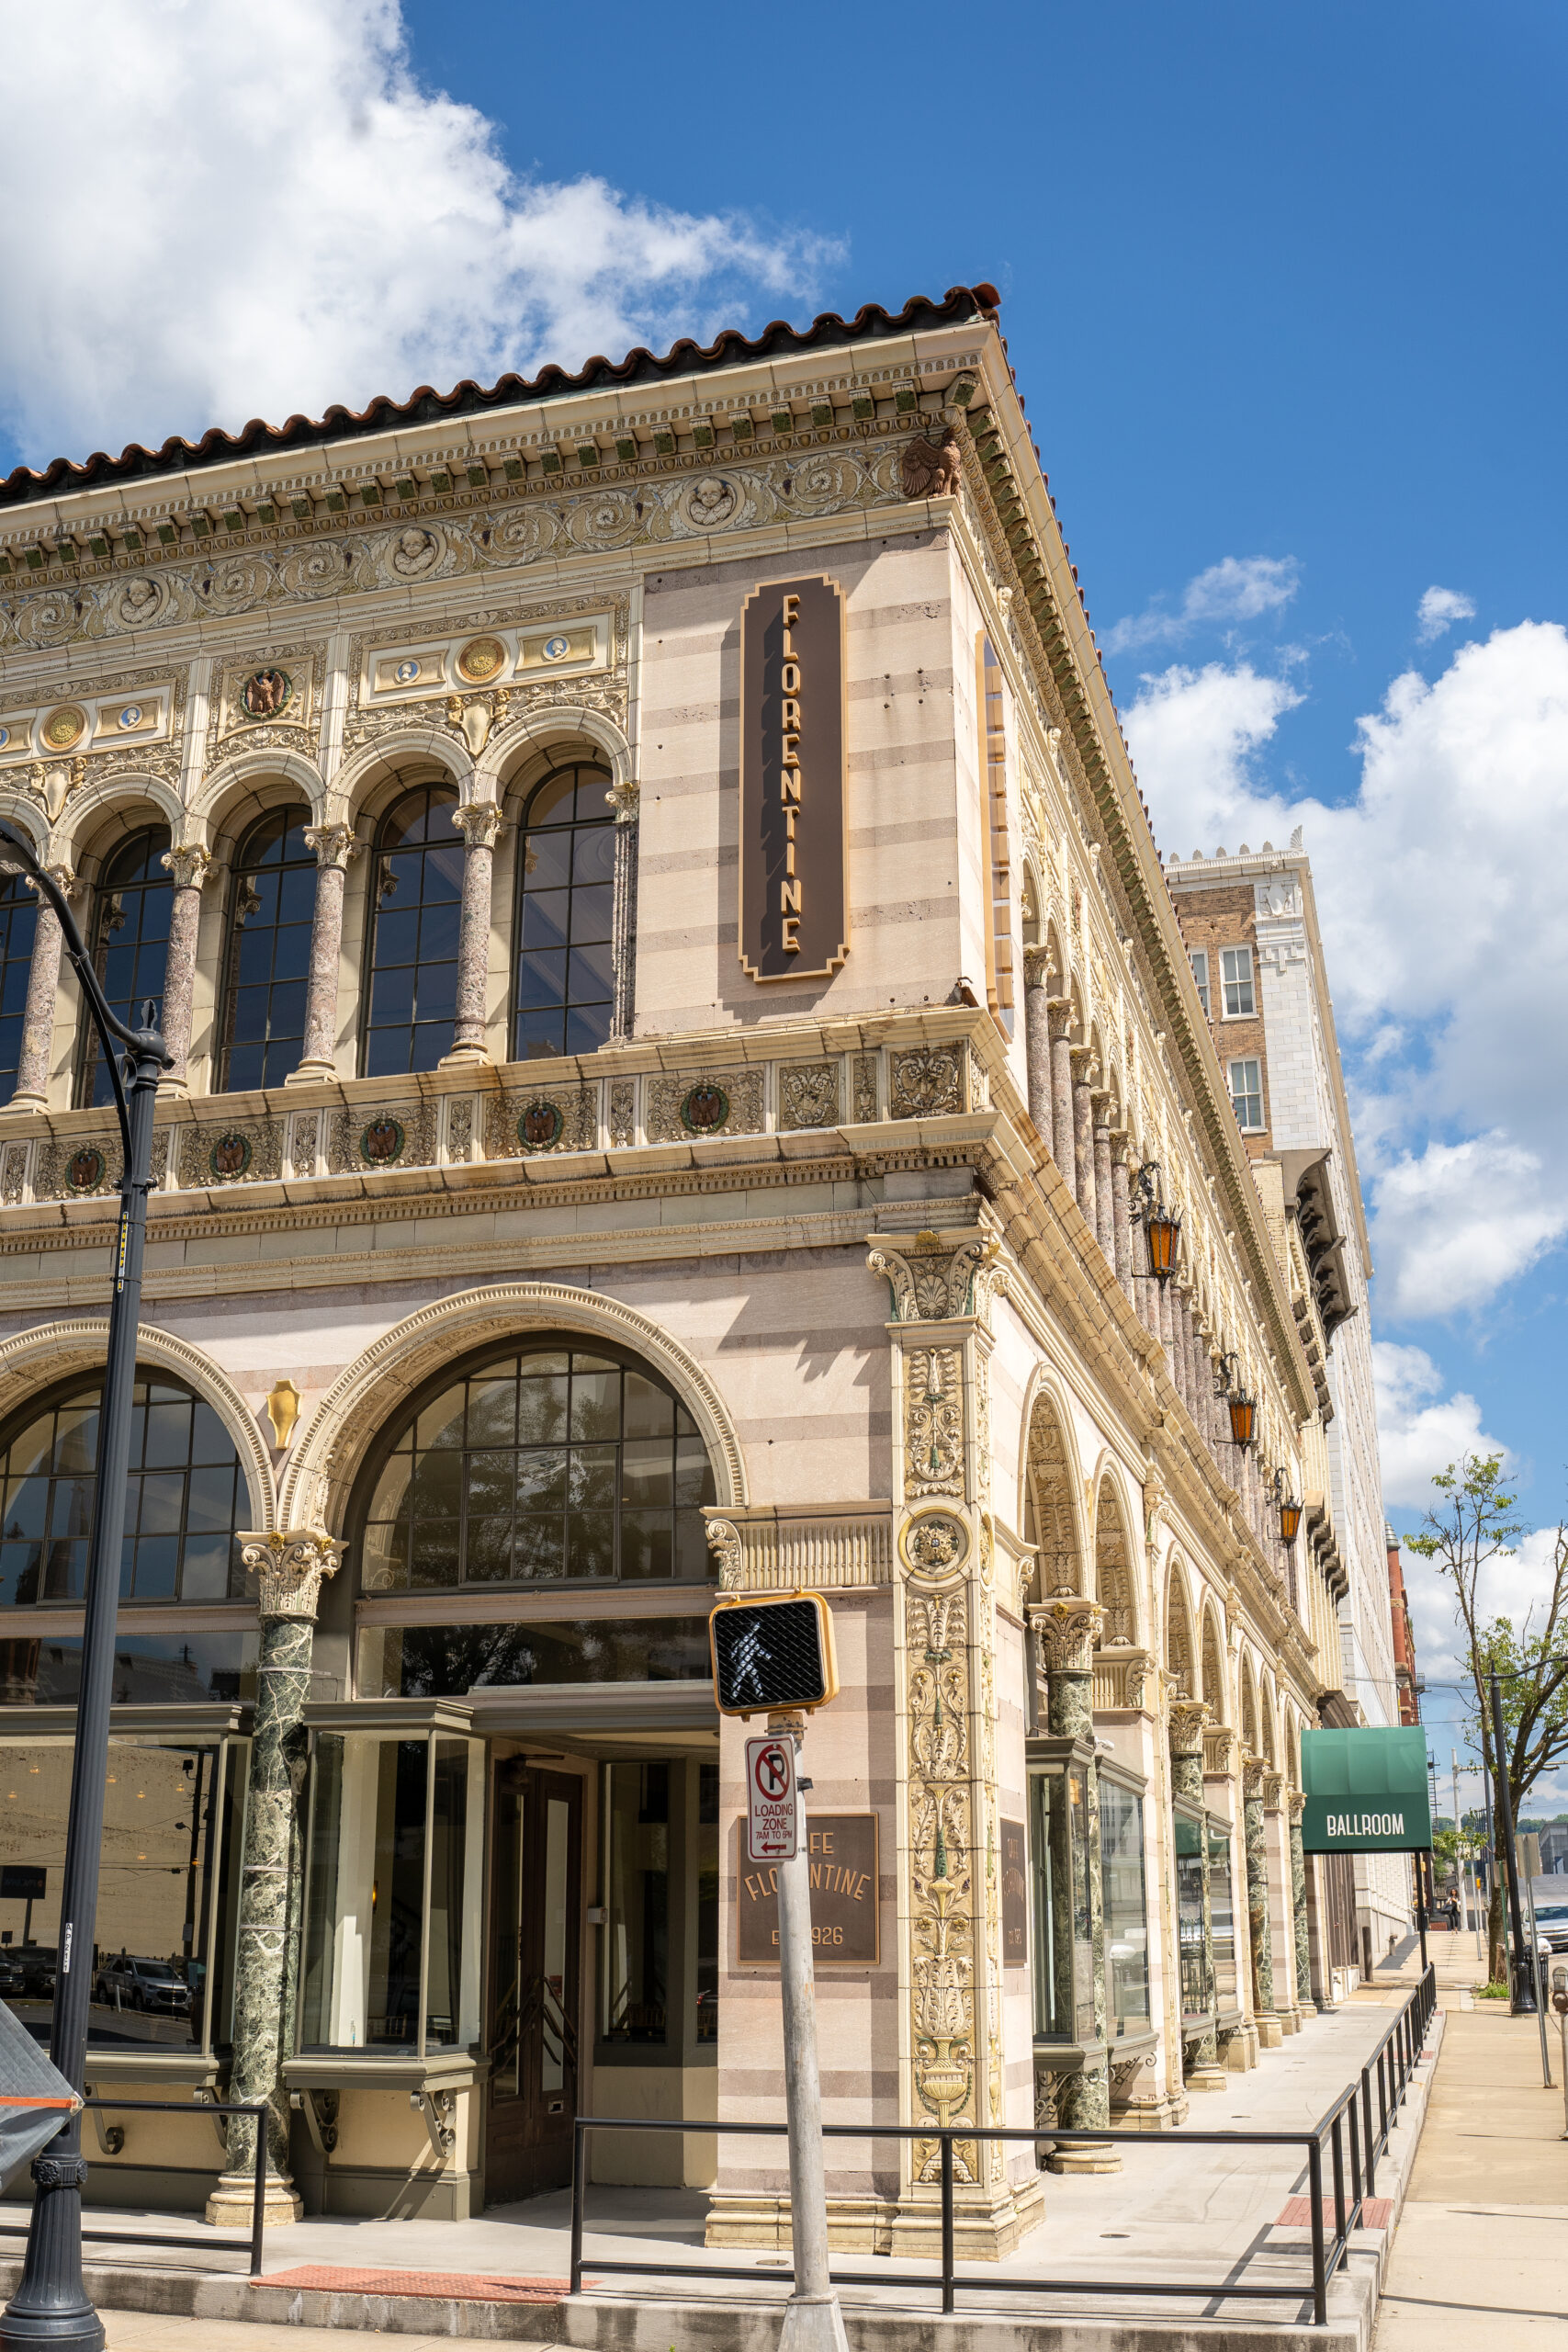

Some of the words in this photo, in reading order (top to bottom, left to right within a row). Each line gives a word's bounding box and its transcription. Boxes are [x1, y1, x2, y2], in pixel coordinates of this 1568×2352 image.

[781, 594, 801, 953] FLORENTINE
[754, 1803, 794, 1817] LOADING
[756, 1831, 770, 1840] 7AM
[772, 1830, 782, 1839] TO
[782, 1829, 793, 1838] 6PM
[762, 1818, 787, 1830] ZONE
[1326, 1813, 1404, 1837] BALLROOM
[809, 1832, 835, 1855] FE
[744, 1862, 872, 1902] FLONTINE
[811, 1926, 844, 1946] 926
